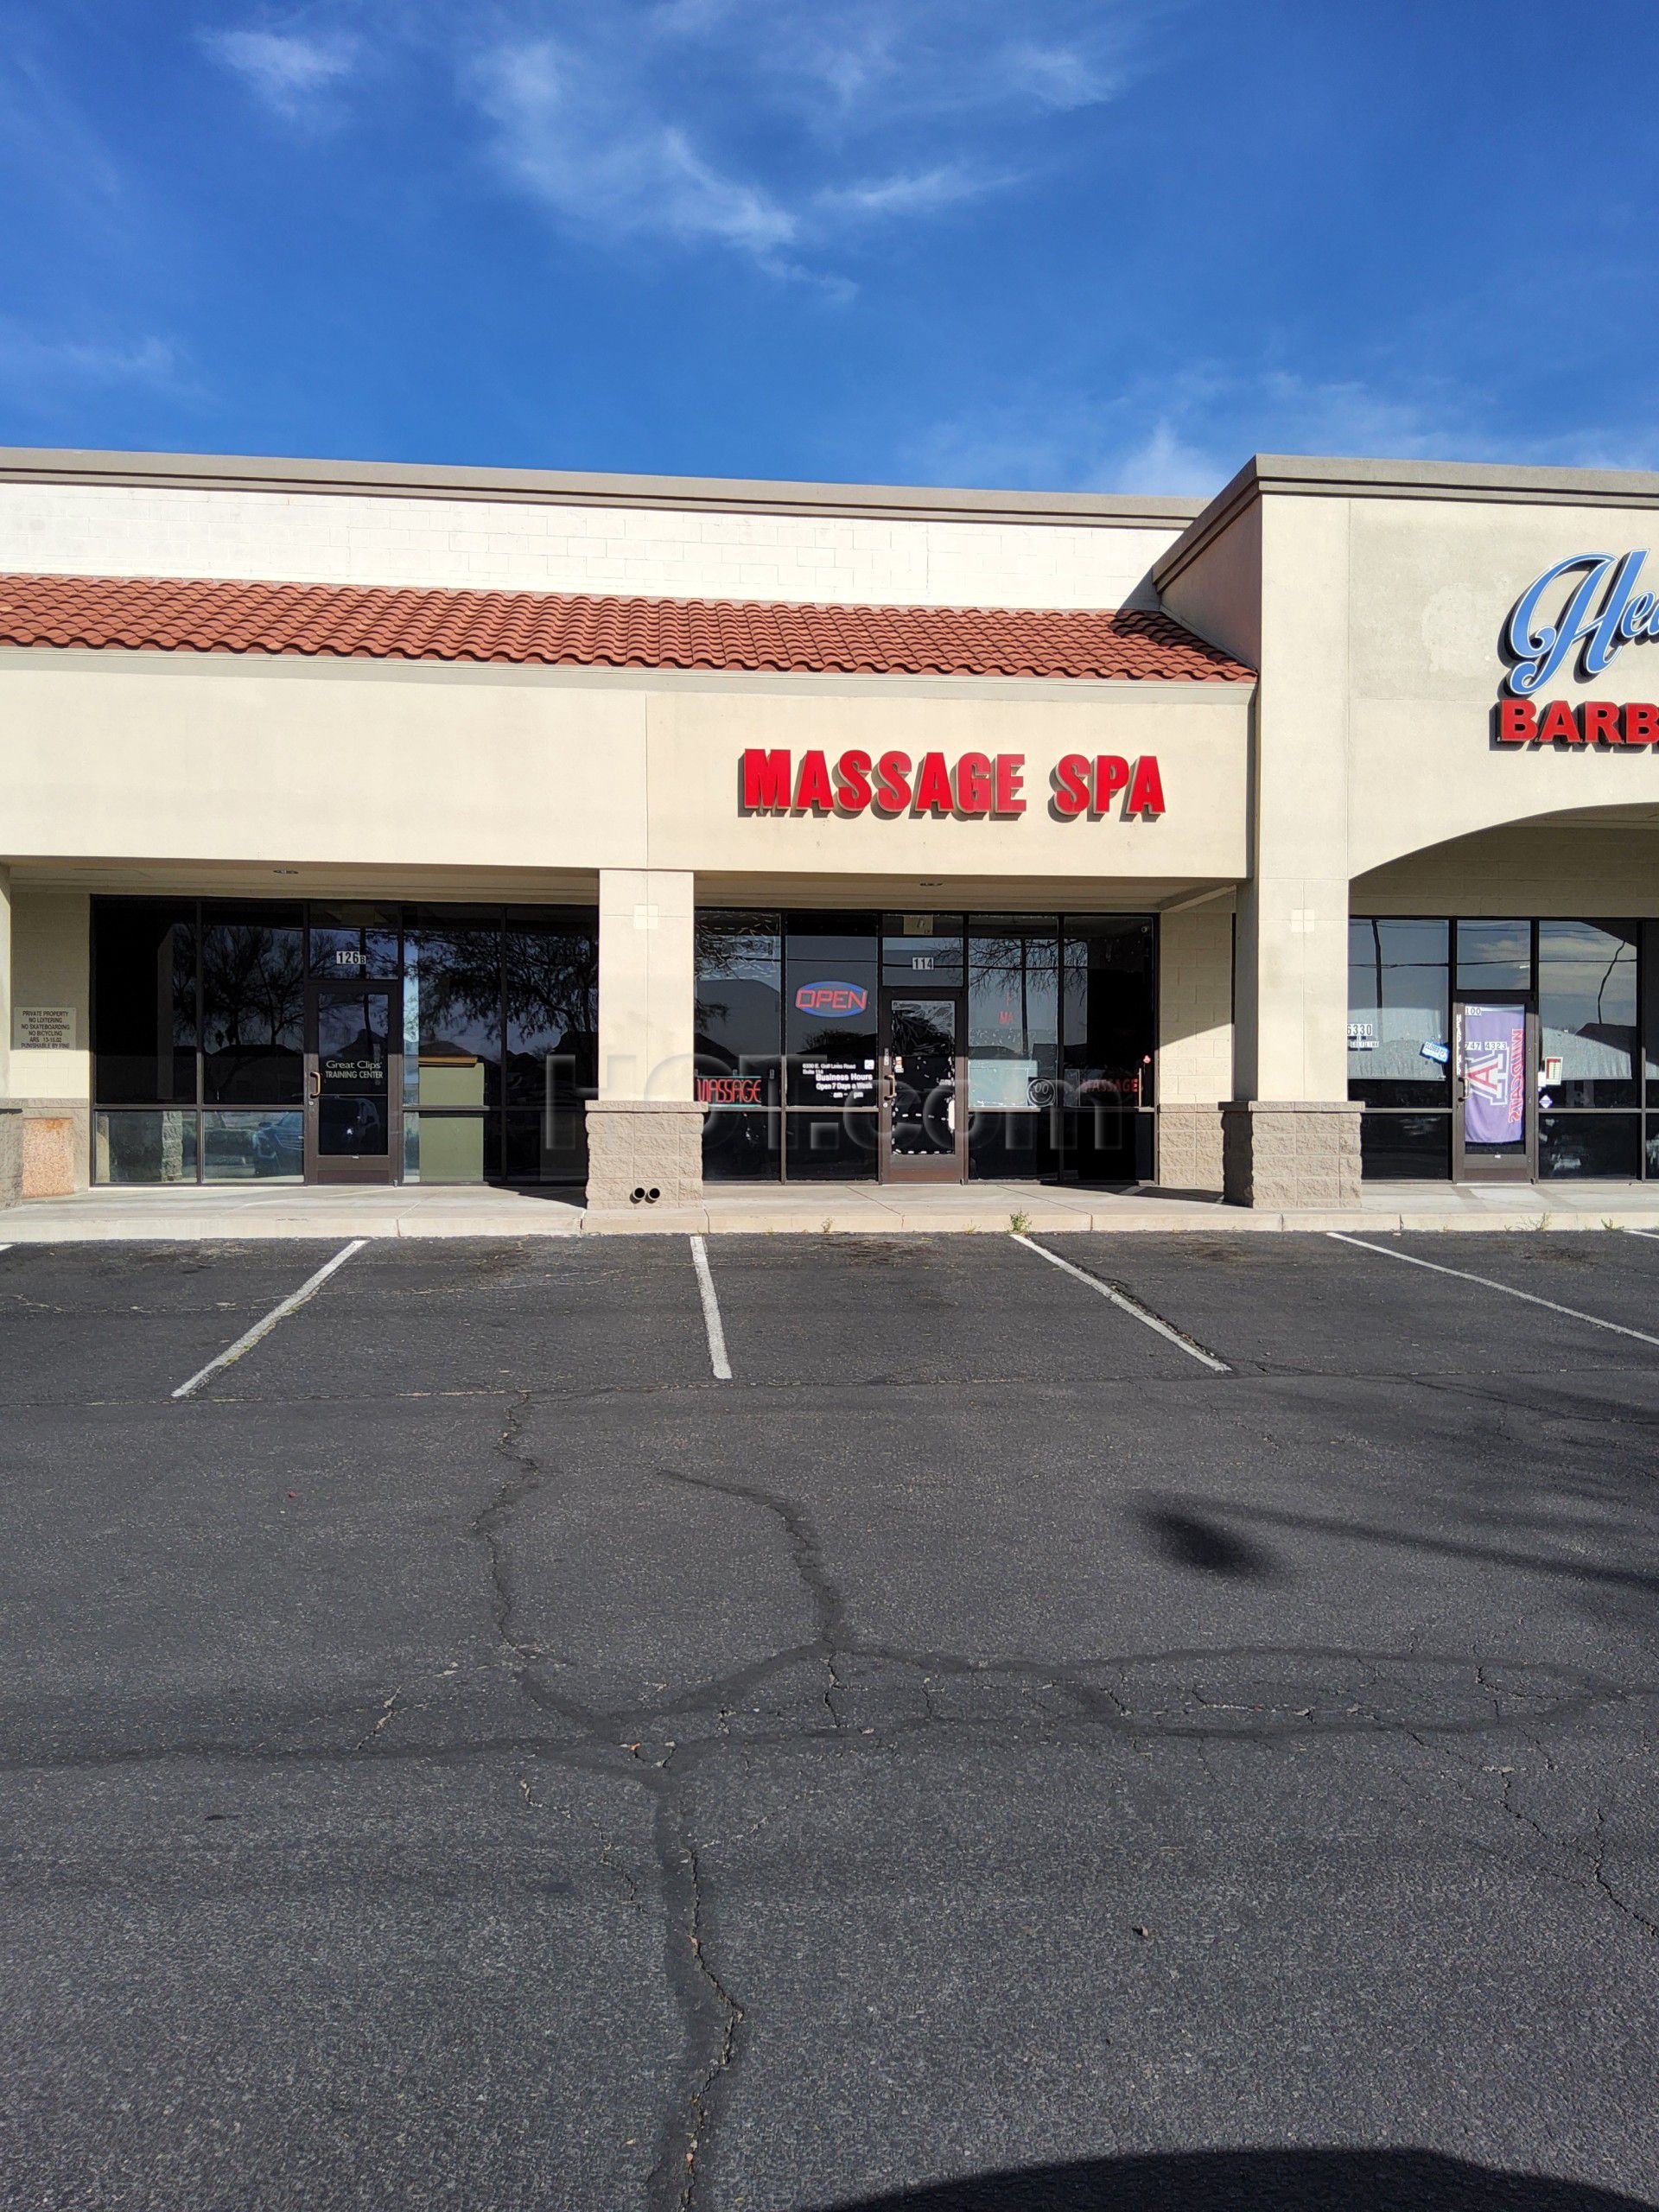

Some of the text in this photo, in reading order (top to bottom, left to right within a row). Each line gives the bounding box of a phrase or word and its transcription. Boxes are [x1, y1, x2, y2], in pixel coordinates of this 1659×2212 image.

[1510, 548, 1659, 695] He
[1501, 699, 1659, 745] BARB
[743, 748, 1166, 815] MASSAGE SPA
[913, 957, 932, 969] 114
[795, 989, 868, 1010] OPEN
[1347, 1024, 1372, 1036] 6330
[326, 1060, 355, 1069] Great
[696, 1078, 762, 1103] MASSAGE
[815, 1082, 831, 1090] Open
[836, 1082, 851, 1090] Days
